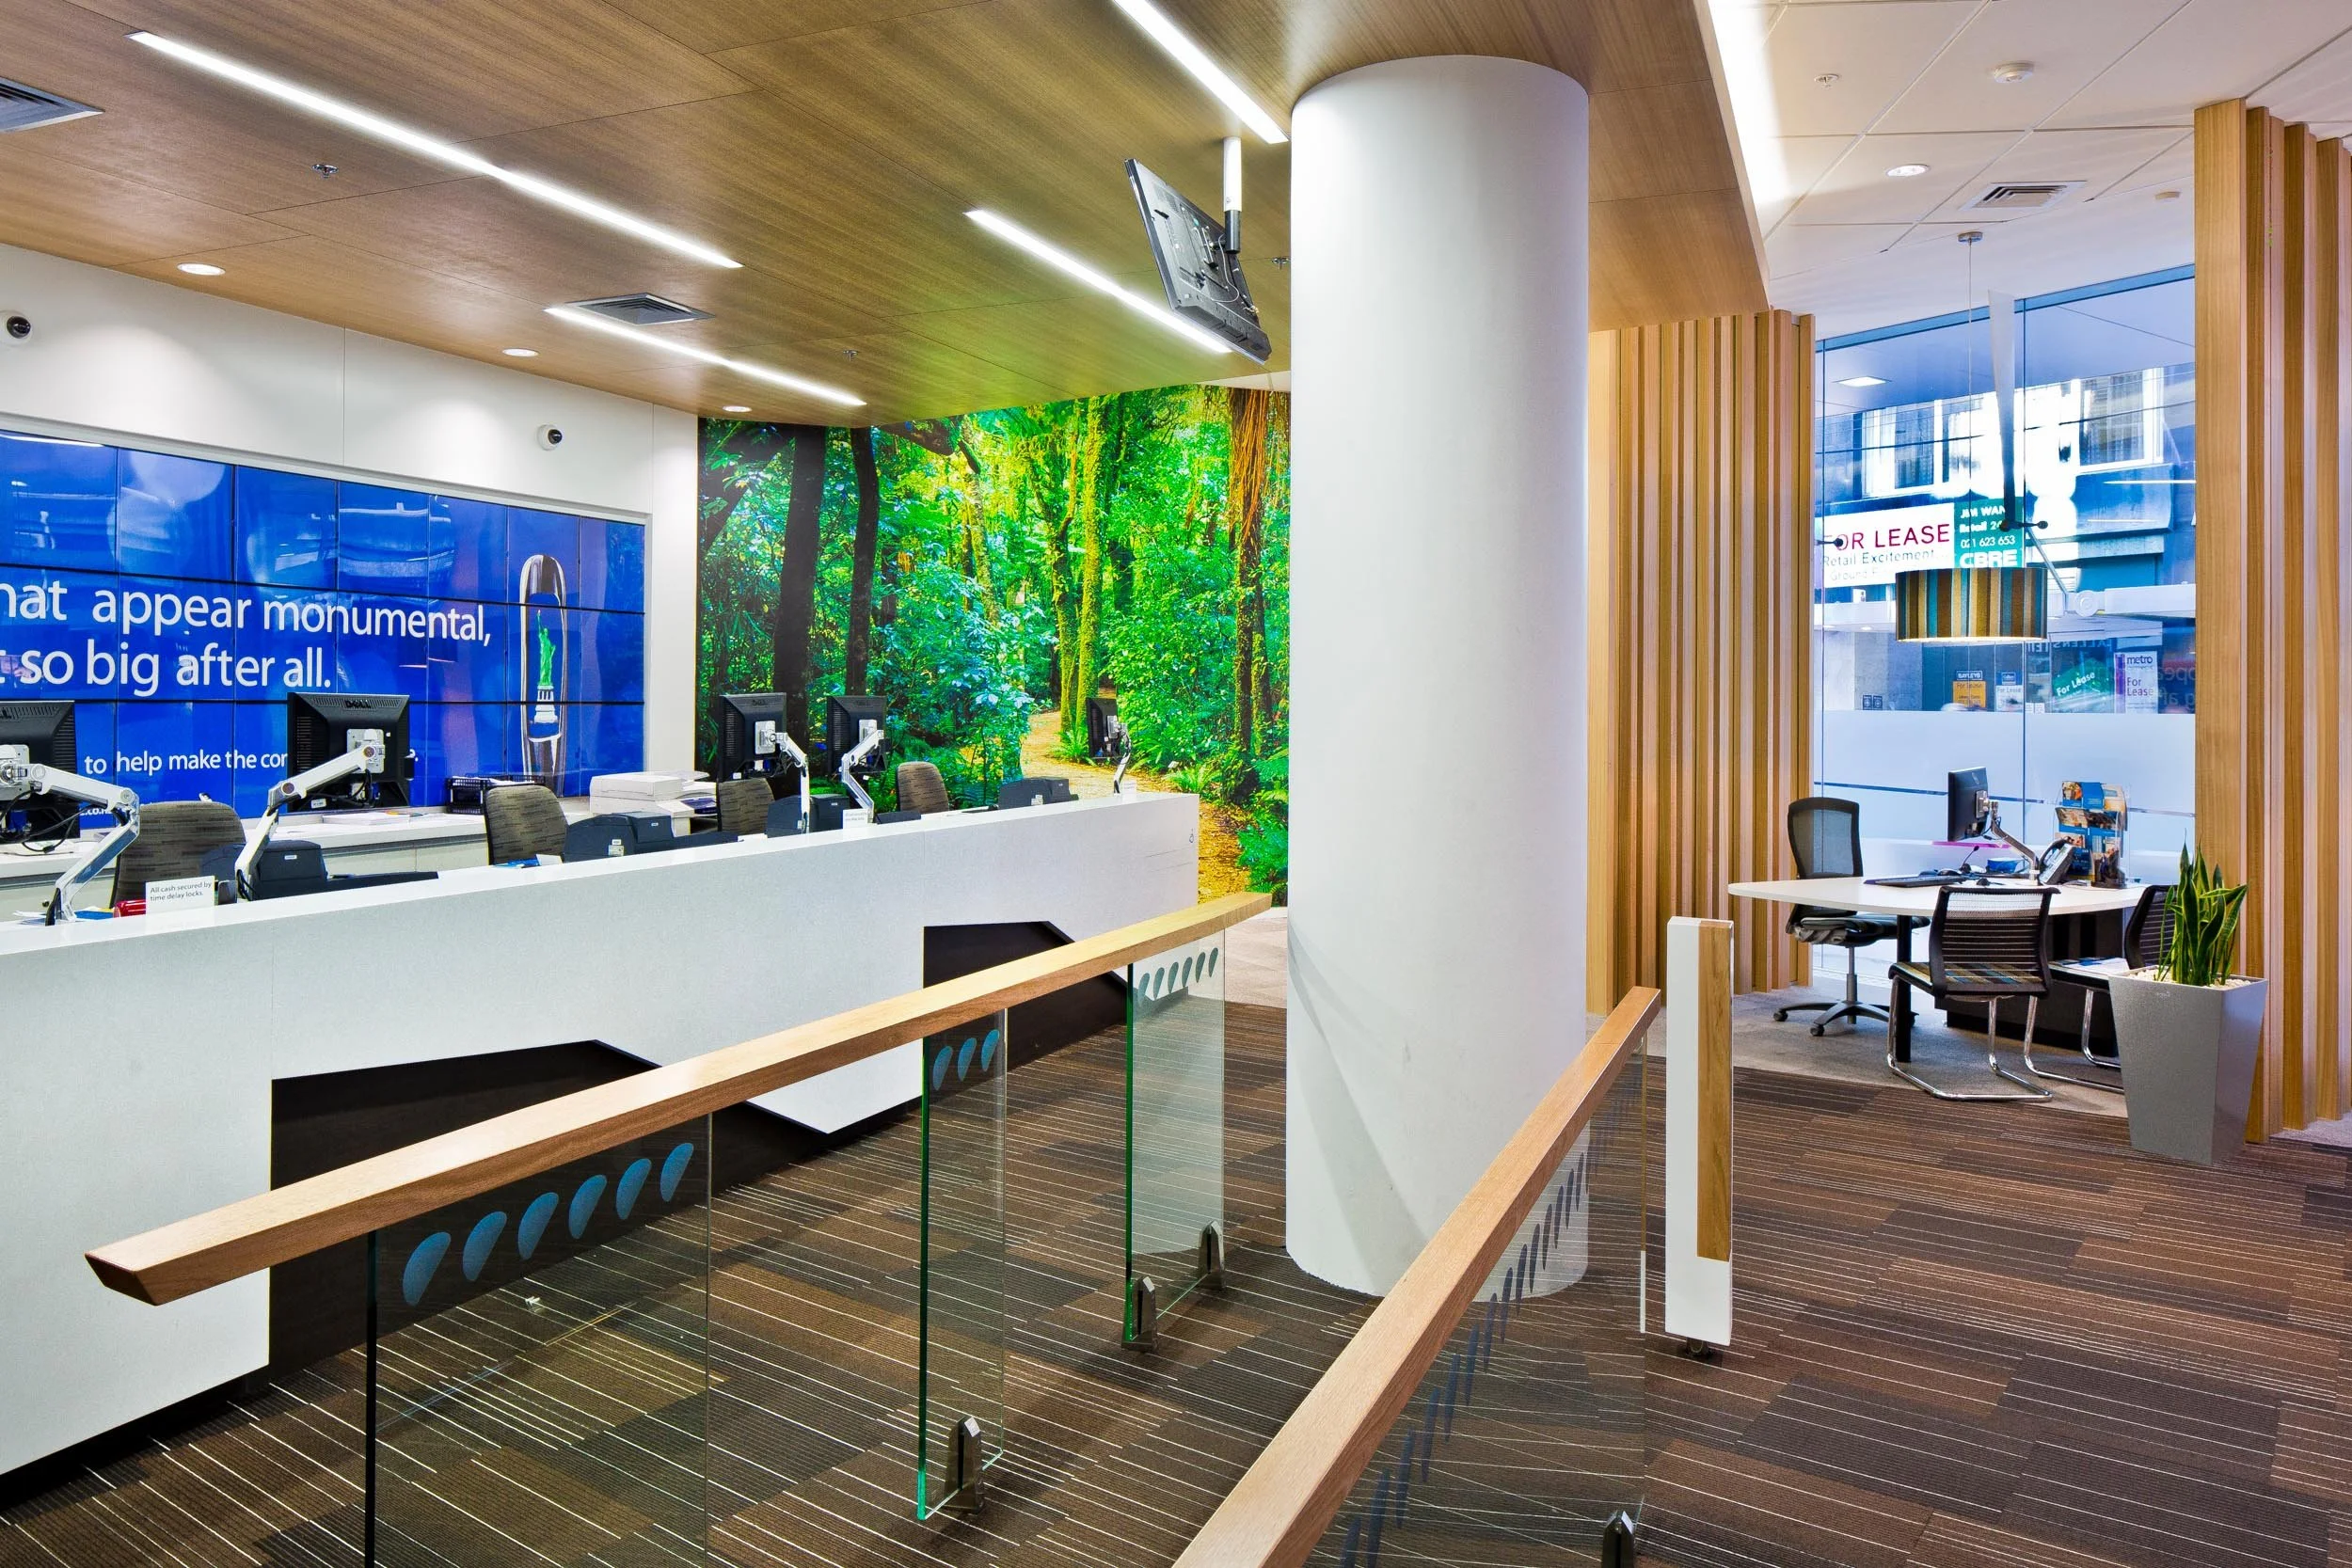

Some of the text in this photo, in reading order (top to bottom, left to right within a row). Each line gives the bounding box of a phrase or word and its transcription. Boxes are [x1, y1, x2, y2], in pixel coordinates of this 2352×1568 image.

[1875, 523, 1950, 548] LEASE
[1979, 536, 1995, 547] 623
[1997, 534, 2016, 546] 653
[1959, 549, 2018, 568] CBRE
[92, 589, 251, 636] appear
[263, 600, 491, 646] monumental,
[21, 650, 74, 684] so
[87, 639, 160, 697] big
[176, 642, 276, 687] after
[283, 647, 331, 688] all.
[2127, 656, 2153, 664] metro
[2057, 672, 2095, 696] For Lease
[2127, 677, 2142, 687] For
[2127, 688, 2153, 697] Lease
[345, 700, 372, 709] DELL
[84, 755, 107, 774] to
[116, 750, 163, 776] help
[168, 749, 221, 769] make
[225, 749, 257, 769] the
